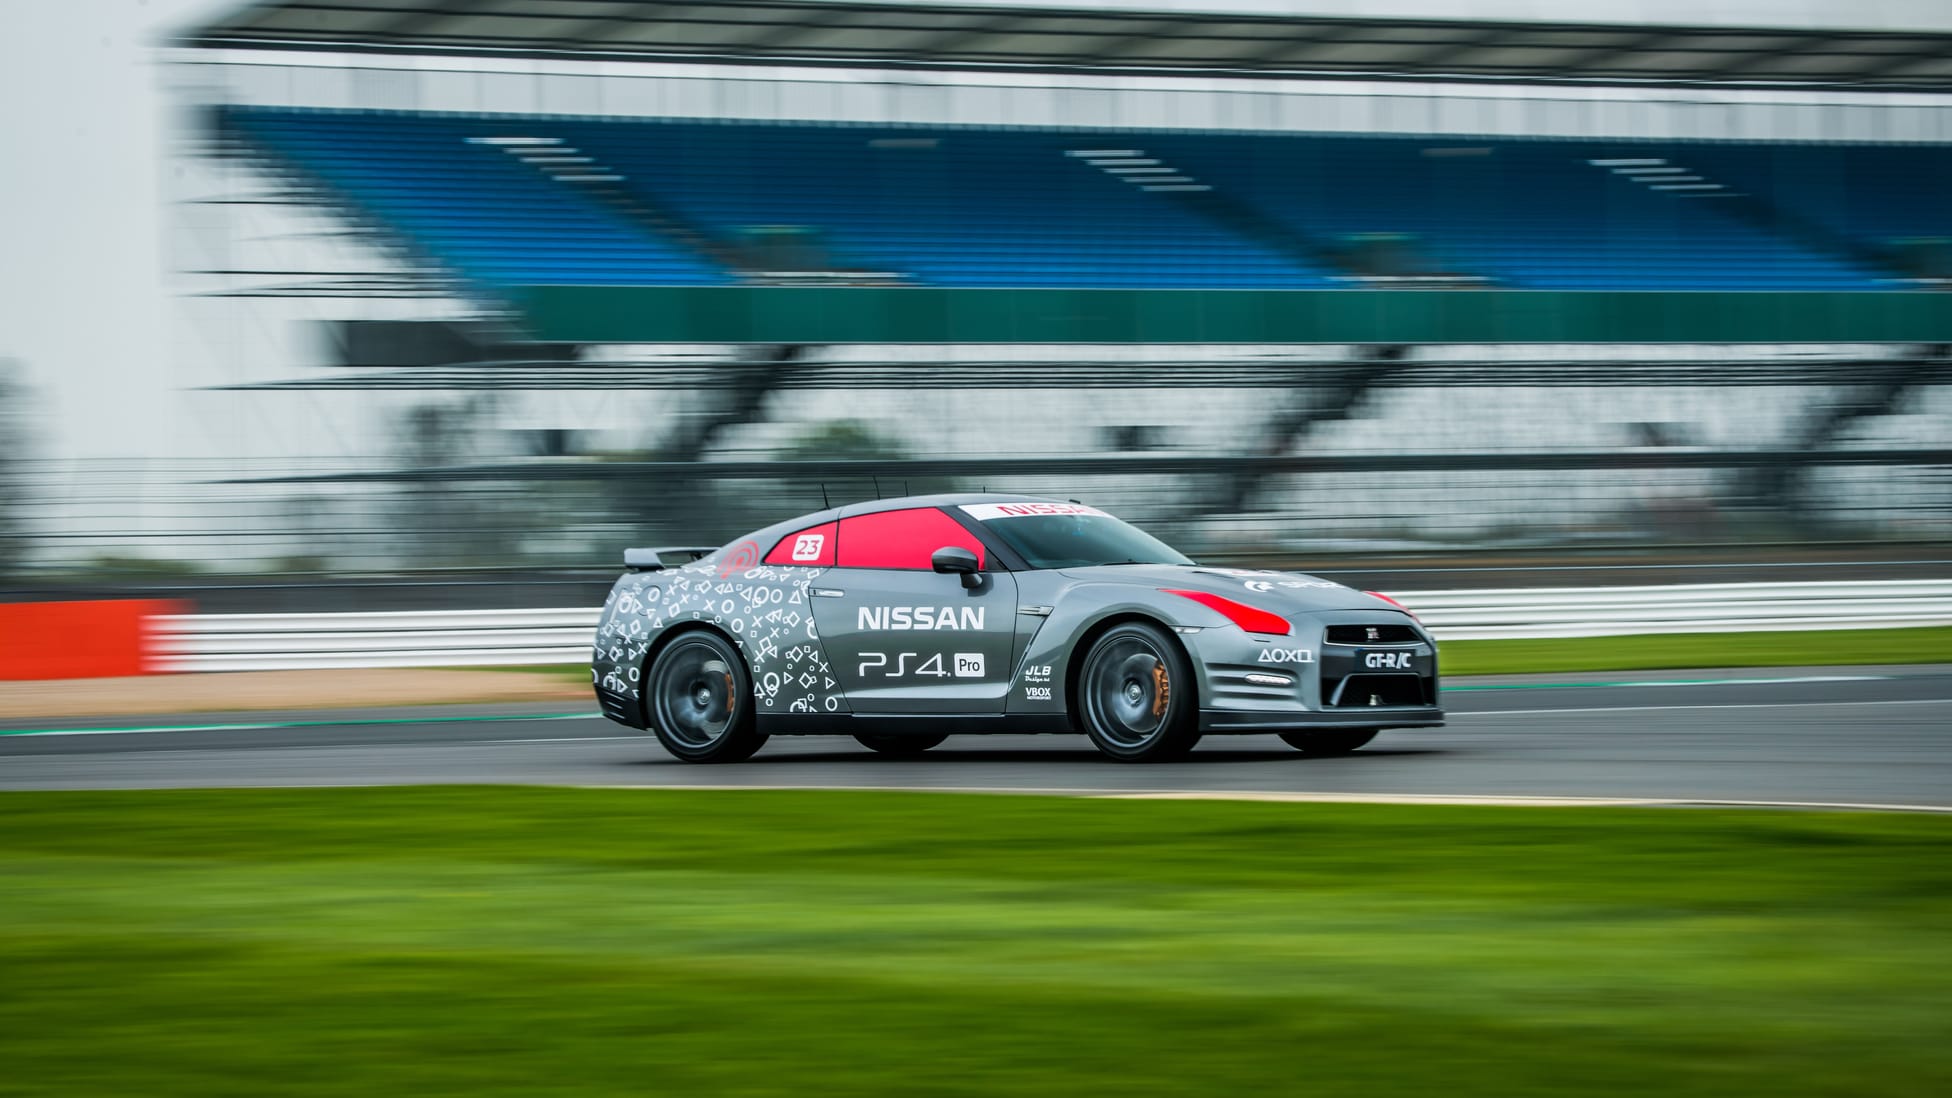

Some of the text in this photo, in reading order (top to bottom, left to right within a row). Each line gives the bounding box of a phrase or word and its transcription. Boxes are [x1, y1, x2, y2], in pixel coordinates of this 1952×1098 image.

[796, 539, 820, 555] 23
[857, 606, 985, 630] NISSAN
[959, 658, 980, 672] Pro
[1365, 652, 1412, 669] GT-R/C
[1025, 665, 1052, 676] JLB
[1025, 687, 1051, 696] VBOX
